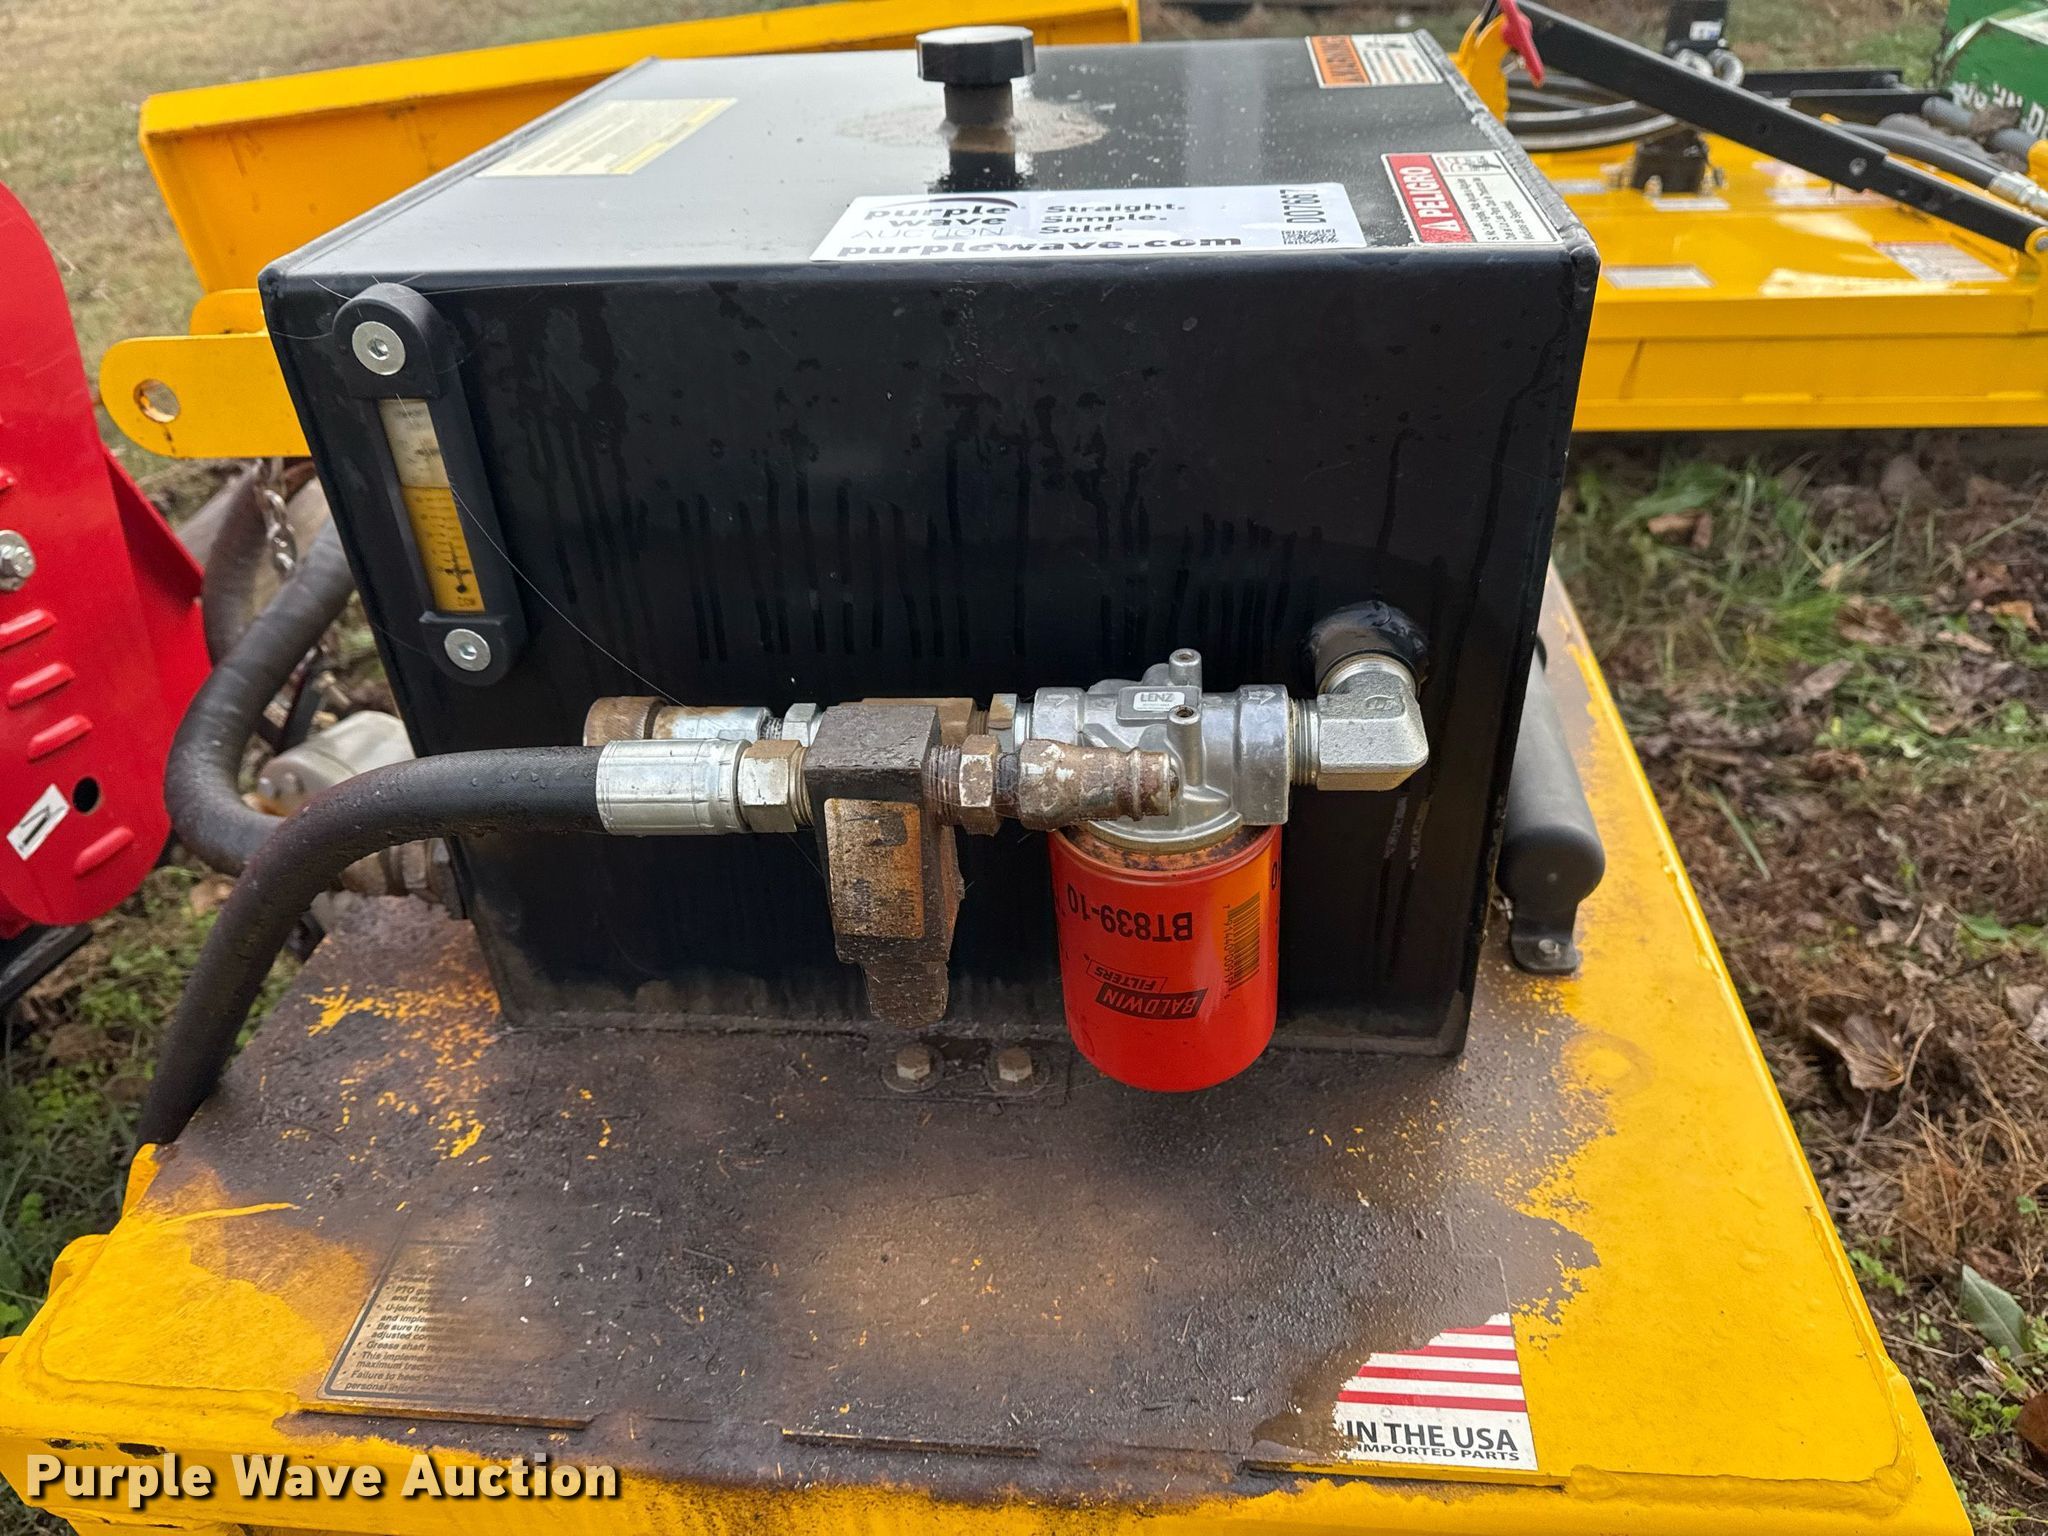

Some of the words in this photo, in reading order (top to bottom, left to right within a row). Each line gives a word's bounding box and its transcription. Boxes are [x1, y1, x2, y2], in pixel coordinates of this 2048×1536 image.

[1399, 166, 1454, 218] PELIGRO
[864, 204, 1010, 220] purple
[1047, 203, 1186, 213] Straight.
[889, 217, 1007, 226] wave
[1042, 213, 1167, 223] Simple.
[851, 227, 1004, 239] AUCTION
[1039, 223, 1123, 234] Sold.
[837, 238, 1241, 257] purplewave.com
[1140, 692, 1174, 702] LENZ
[1067, 883, 1193, 942] BT839-10
[1093, 965, 1157, 992] FILTERS
[1101, 987, 1197, 1016] BALDWIN
[385, 1304, 415, 1313] U-joint
[380, 1314, 398, 1322] and
[376, 1322, 388, 1330] Be
[371, 1331, 411, 1340] adjusted
[366, 1341, 400, 1350] Grease
[400, 1342, 426, 1351] shaft
[362, 1351, 382, 1360] This
[356, 1361, 401, 1370] maximum
[351, 1371, 384, 1380] Failure
[385, 1372, 395, 1380] to
[345, 1383, 387, 1391] personal
[1346, 1420, 1378, 1443] IN
[1384, 1423, 1445, 1447] THE
[1453, 1427, 1518, 1451] USA
[1357, 1444, 1455, 1457] IMPORTED
[1461, 1449, 1520, 1461] PARTS
